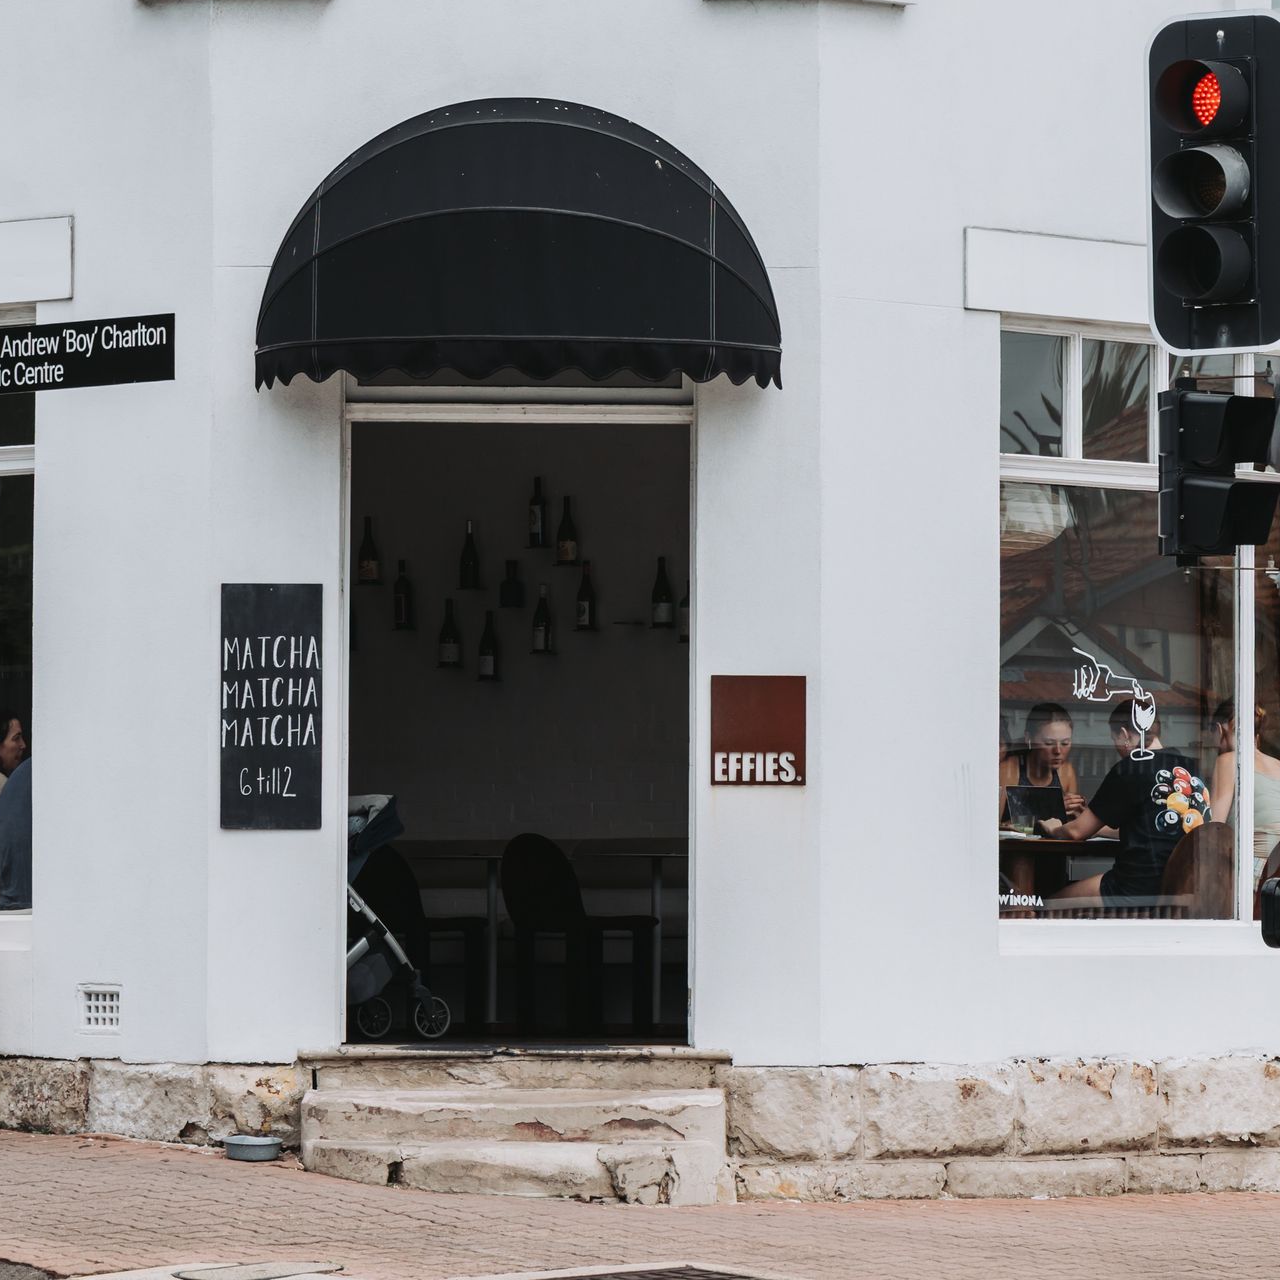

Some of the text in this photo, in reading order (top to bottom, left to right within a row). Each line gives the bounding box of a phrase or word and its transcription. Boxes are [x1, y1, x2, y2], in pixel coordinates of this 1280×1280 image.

[0, 331, 60, 359] Andrew
[101, 322, 167, 350] Charlton
[13, 362, 64, 387] Centre
[223, 635, 322, 671] MATCHA
[222, 676, 318, 709] MATCHA
[221, 713, 317, 748] MATCHA
[239, 767, 252, 796] 6
[714, 751, 802, 783] EFFIES.
